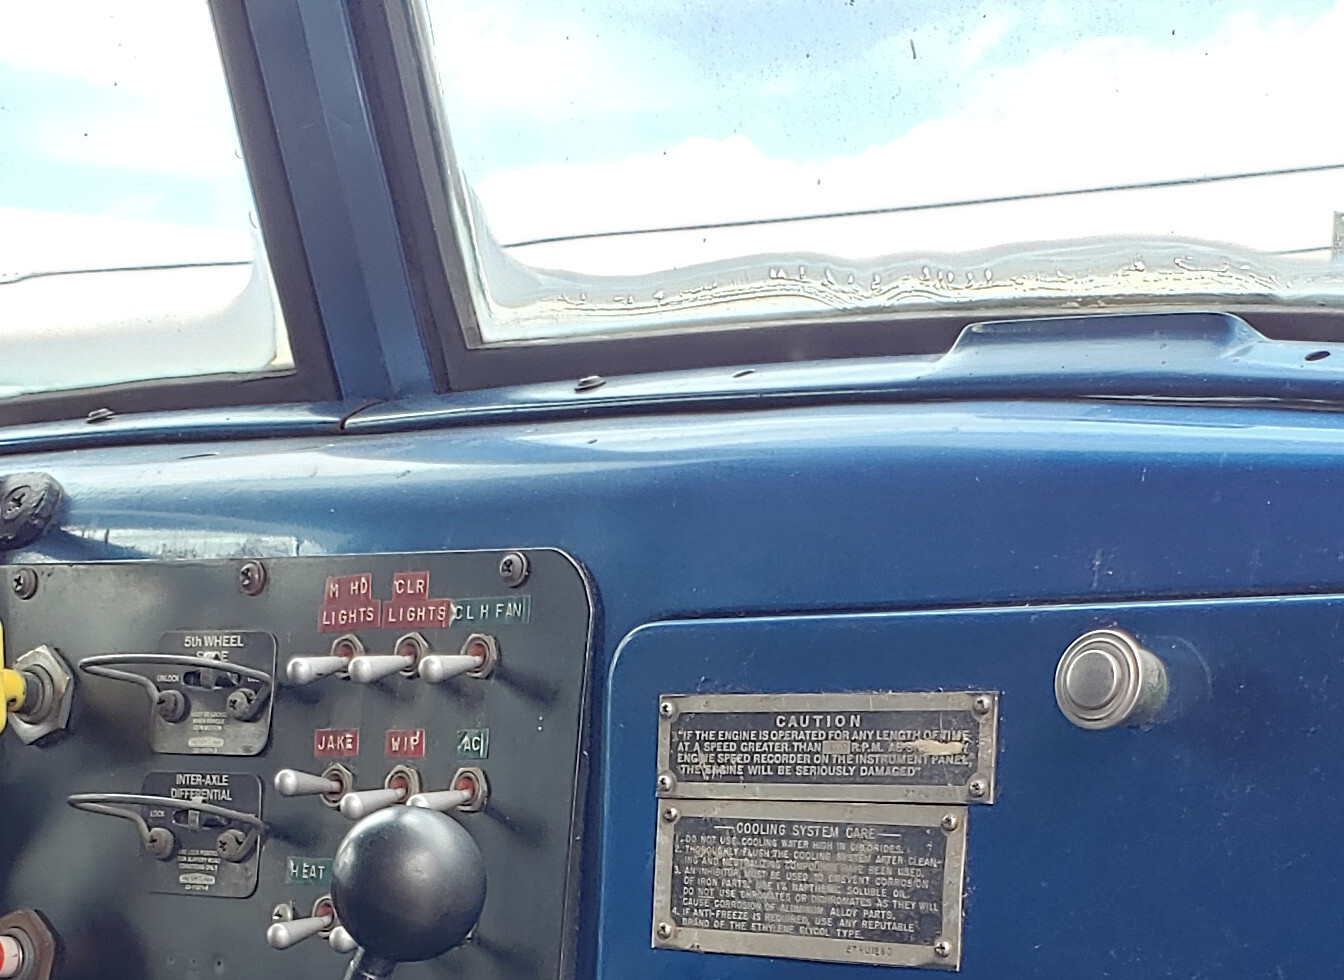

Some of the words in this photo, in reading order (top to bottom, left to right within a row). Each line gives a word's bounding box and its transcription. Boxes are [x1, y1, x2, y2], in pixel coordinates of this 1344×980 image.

[329, 582, 339, 599] M
[394, 578, 425, 595] CLR
[322, 606, 375, 626] LIGHTS
[388, 605, 447, 622] LIGHTS
[495, 602, 523, 618] FAN
[184, 635, 202, 648] 5th
[204, 634, 244, 648] WHEEL
[775, 714, 862, 728] CAUTION
[317, 734, 354, 751] JAKE
[695, 730, 716, 741] THE
[718, 730, 757, 742] ENGINE
[759, 730, 769, 741] IS
[770, 730, 826, 741] OPERATED
[828, 730, 850, 741] FOR
[851, 730, 875, 741] ANY
[876, 730, 921, 741] LENGTH
[677, 742, 690, 752] AT
[693, 742, 702, 752] A
[703, 742, 737, 752] SPEED
[740, 742, 789, 752] GREATER
[792, 742, 822, 752] THAN
[851, 742, 884, 752] R.P.M.
[717, 753, 751, 764] SPEED
[753, 753, 811, 764] RECORDER
[813, 754, 829, 764] ON
[832, 754, 853, 764] THE
[855, 754, 929, 765] INSTRUMENT
[747, 765, 774, 776] WILL
[777, 765, 792, 776] BE
[795, 765, 856, 776] SERIOUSLY
[175, 773, 229, 786] INTER-AXLE
[170, 787, 233, 801] DIFFERENTIAL
[736, 822, 786, 836] COOLING
[792, 825, 839, 838] SYSTEM
[845, 827, 876, 840] CARE
[685, 835, 697, 843] DO
[700, 835, 717, 844] NOT
[741, 837, 778, 847] COOLING
[781, 839, 809, 849] WATER
[812, 841, 833, 851] HIGH
[701, 857, 719, 866] AND
[774, 849, 789, 859] THE
[793, 850, 832, 861] COOLING
[875, 855, 904, 866] AFTER
[288, 859, 327, 879] HEAT
[786, 872, 809, 882] USED
[683, 876, 695, 885] OF
[697, 877, 718, 887] IRON
[846, 886, 888, 897] SOLUBLE
[682, 887, 695, 896] DO
[697, 888, 715, 898] NOT
[719, 889, 736, 898] USE
[794, 893, 807, 903] OR
[875, 898, 889, 908] AS
[892, 899, 916, 910] THEY
[918, 901, 939, 912] WILL
[682, 898, 710, 907] CAUSE
[713, 899, 762, 911] CORROSION
[829, 907, 858, 918] ALLOY
[682, 907, 691, 916] IF
[692, 908, 749, 921] ANTI-FREEZE
[752, 912, 761, 921] IS
[815, 917, 833, 927] USE
[839, 918, 858, 928] ANY
[861, 920, 915, 933] REPUTABLE
[682, 917, 710, 928] BRAND
[713, 919, 725, 929] OF
[729, 921, 747, 931] THE
[751, 922, 795, 934] ETHYLENE
